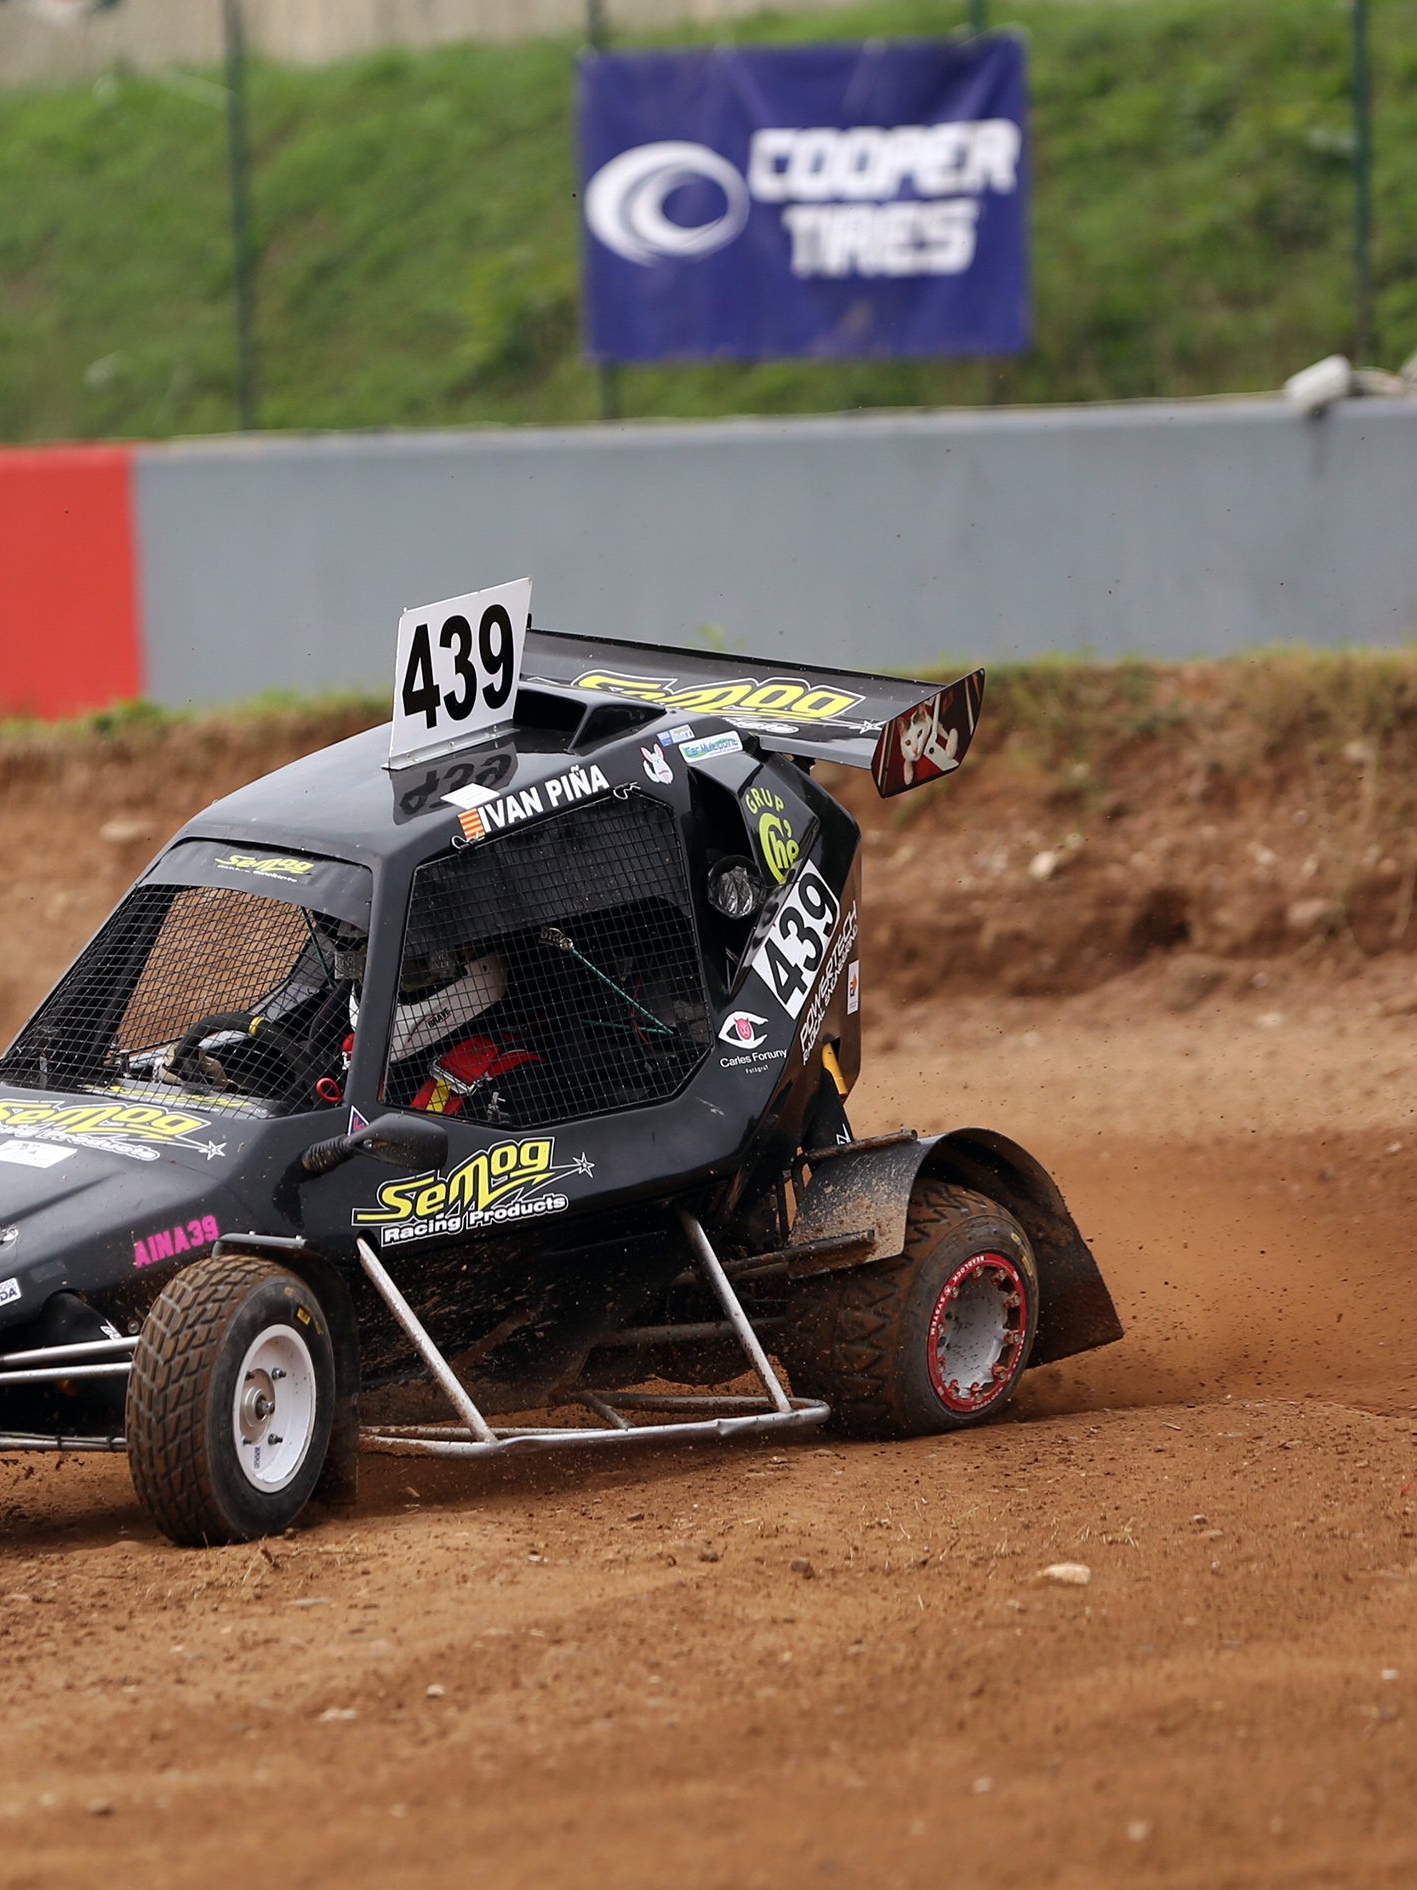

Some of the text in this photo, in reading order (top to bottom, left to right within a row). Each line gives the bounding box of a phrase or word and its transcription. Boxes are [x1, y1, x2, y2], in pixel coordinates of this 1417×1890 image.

[750, 118, 1021, 202] COOPER
[782, 199, 979, 278] TIRES
[402, 604, 514, 730] 439
[478, 787, 544, 833] IVAN
[544, 764, 610, 808] PIÑA
[745, 787, 784, 814] GRUP
[764, 872, 834, 1005] 439
[799, 900, 857, 1052] POWERTECH
[720, 1048, 788, 1068] Carles Fortuny
[45, 1128, 159, 1161] Products
[134, 1214, 219, 1268] AINA39
[383, 1193, 567, 1244] Racing Products
